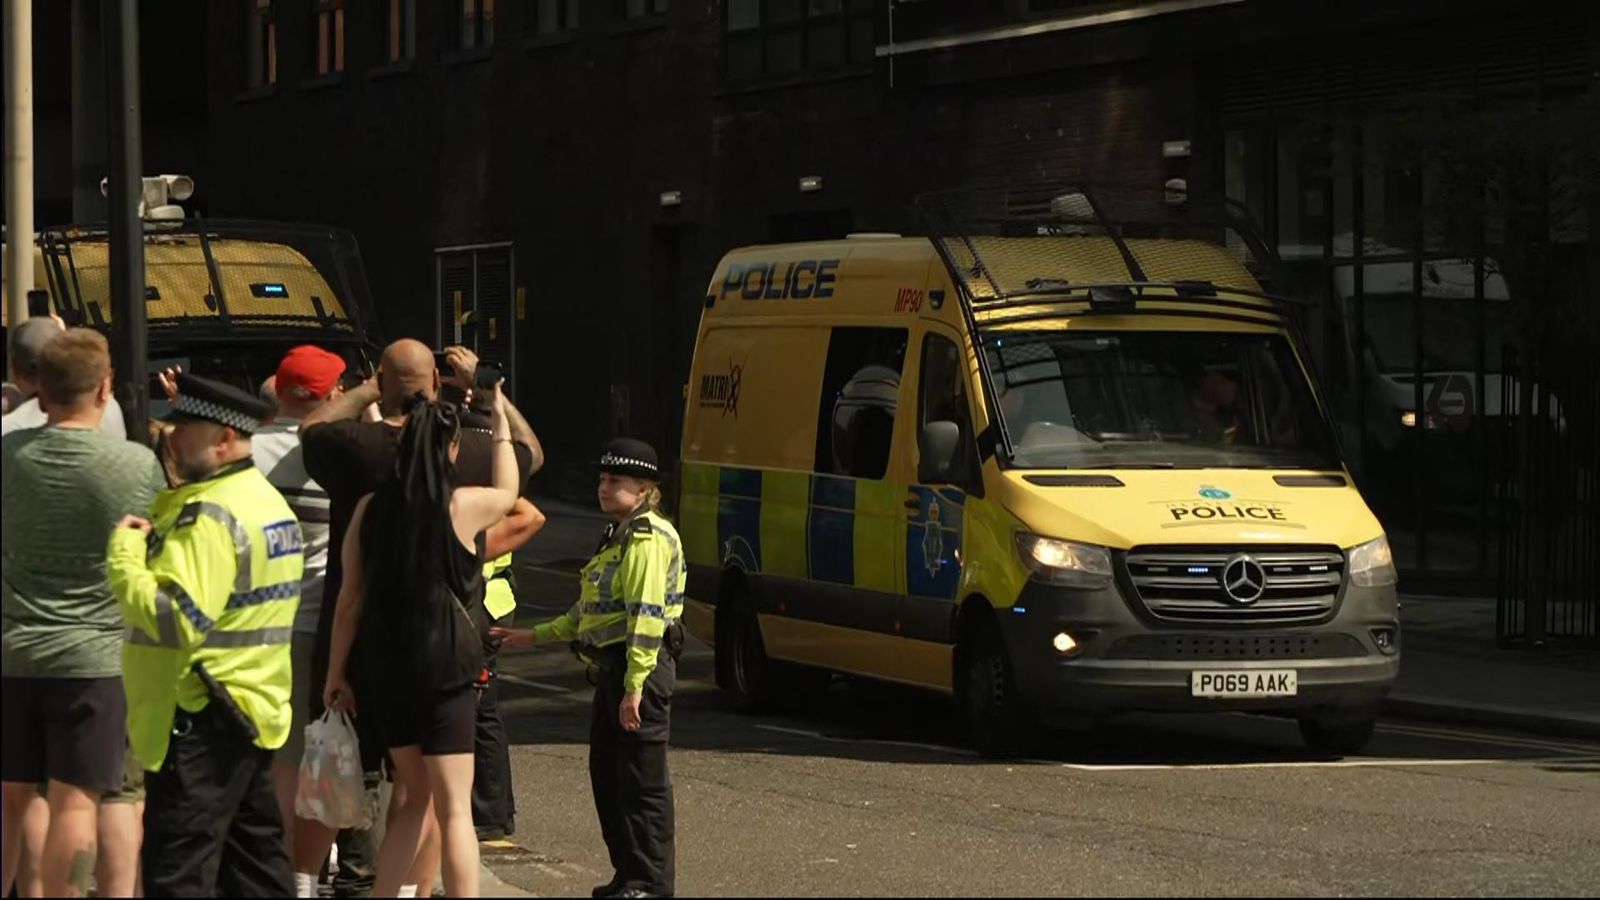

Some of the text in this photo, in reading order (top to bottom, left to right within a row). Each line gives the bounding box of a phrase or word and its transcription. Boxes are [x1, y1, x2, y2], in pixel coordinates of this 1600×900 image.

[720, 259, 840, 300] POLICE
[894, 288, 923, 313] MP90
[1170, 506, 1287, 521] POLICE
[1201, 673, 1288, 692] PO69 AAK
